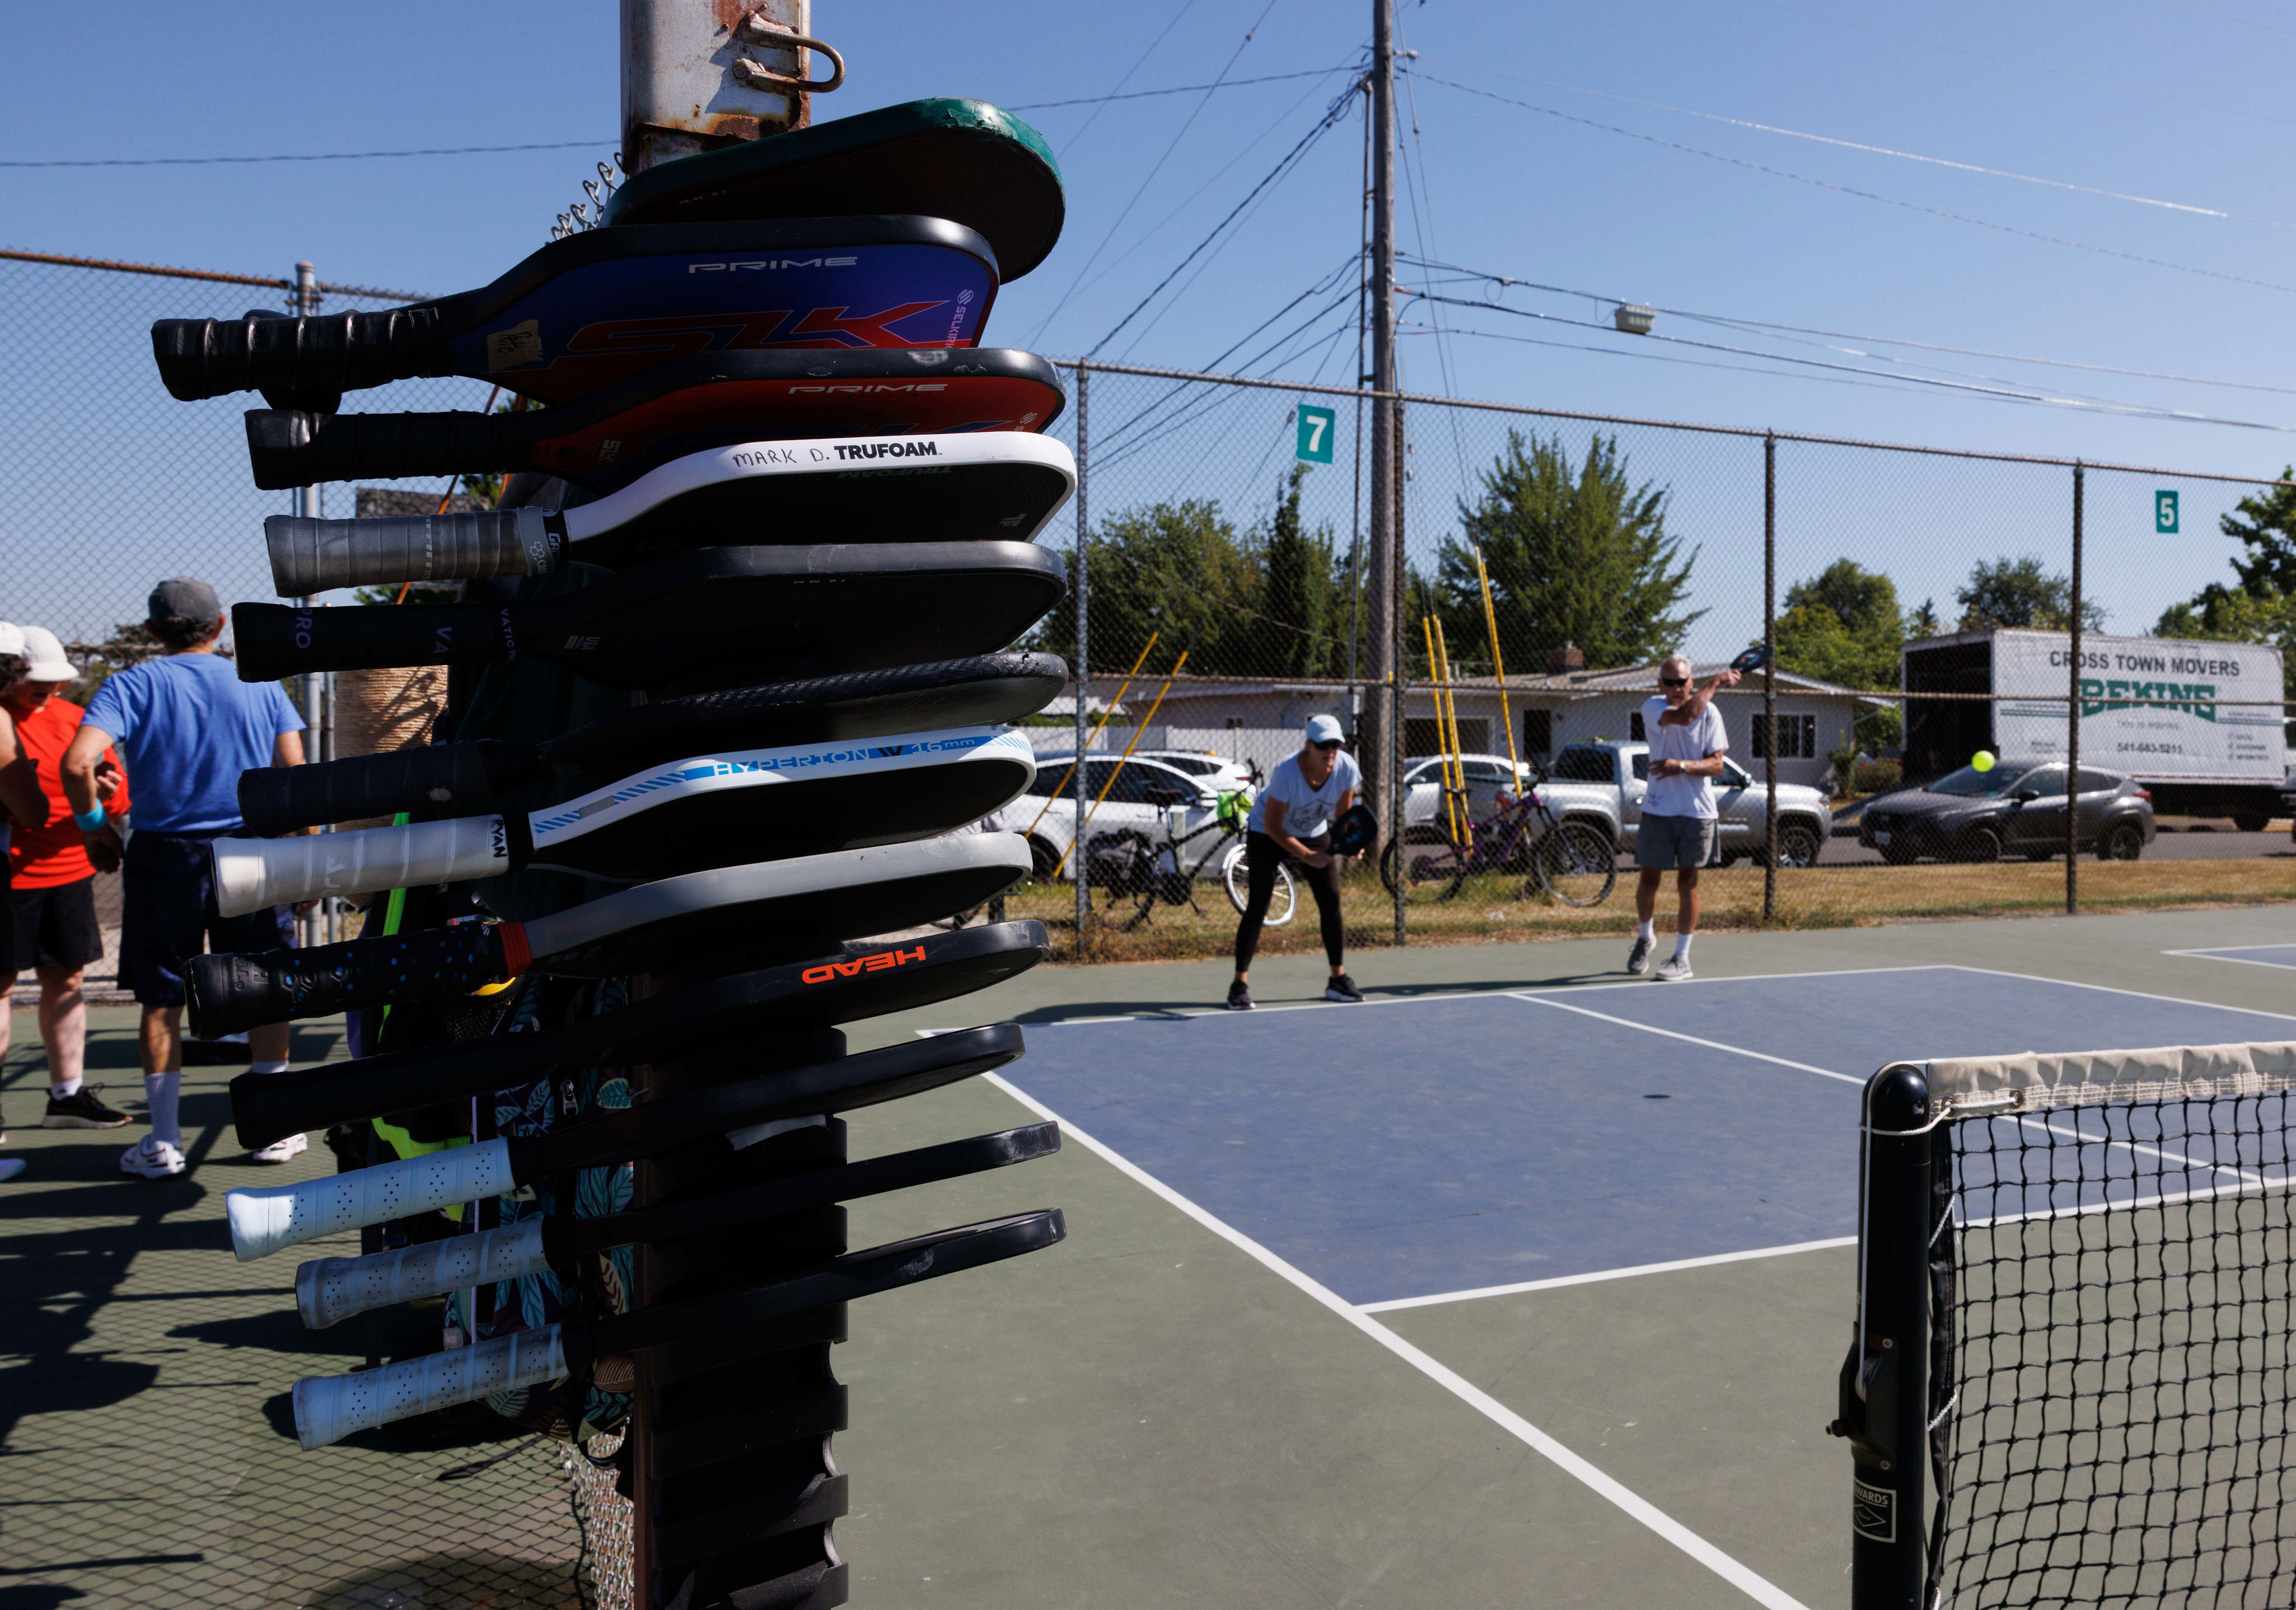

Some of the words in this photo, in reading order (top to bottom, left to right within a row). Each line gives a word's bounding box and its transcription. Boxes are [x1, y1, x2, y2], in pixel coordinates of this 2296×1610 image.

[689, 256, 858, 273] PRIME
[788, 384, 948, 394] PRIME
[1306, 415, 1327, 452] 7
[732, 448, 797, 467] MARK
[810, 448, 830, 462] D.
[2159, 498, 2175, 527] 5
[295, 609, 314, 649] PRO
[500, 608, 515, 648] VATIC
[580, 636, 601, 650] USA
[2050, 651, 2110, 670] CROSS
[2115, 654, 2166, 672] TOWN
[2172, 658, 2240, 676] MOVERS
[2079, 678, 2216, 723] BEKINS
[714, 748, 870, 775] HYPERION
[490, 819, 508, 858] RYAN
[802, 946, 927, 984] HEAD
